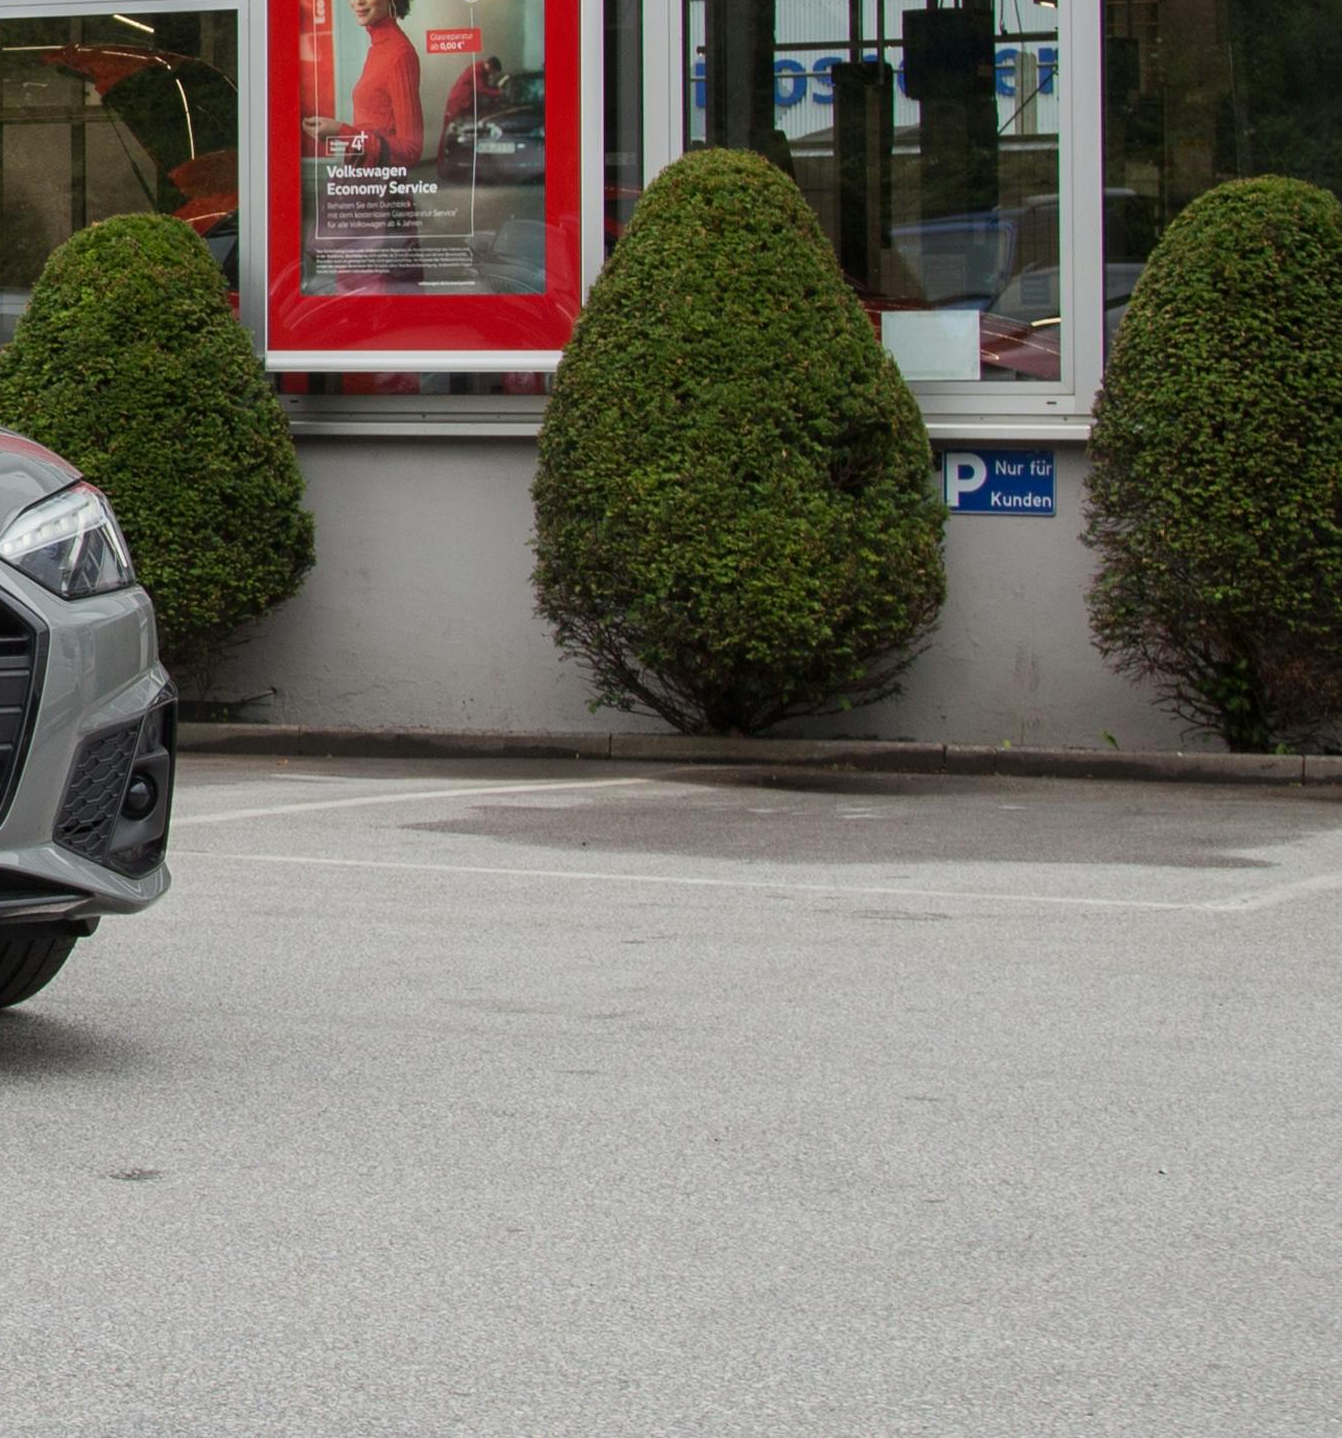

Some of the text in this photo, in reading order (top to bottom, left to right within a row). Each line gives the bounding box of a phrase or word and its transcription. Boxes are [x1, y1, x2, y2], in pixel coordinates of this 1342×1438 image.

[326, 164, 408, 180] Volkswagen
[327, 180, 439, 197] Economy Service
[995, 459, 1052, 476] Nur für
[946, 452, 987, 507] P
[991, 490, 1052, 508] Kunden
